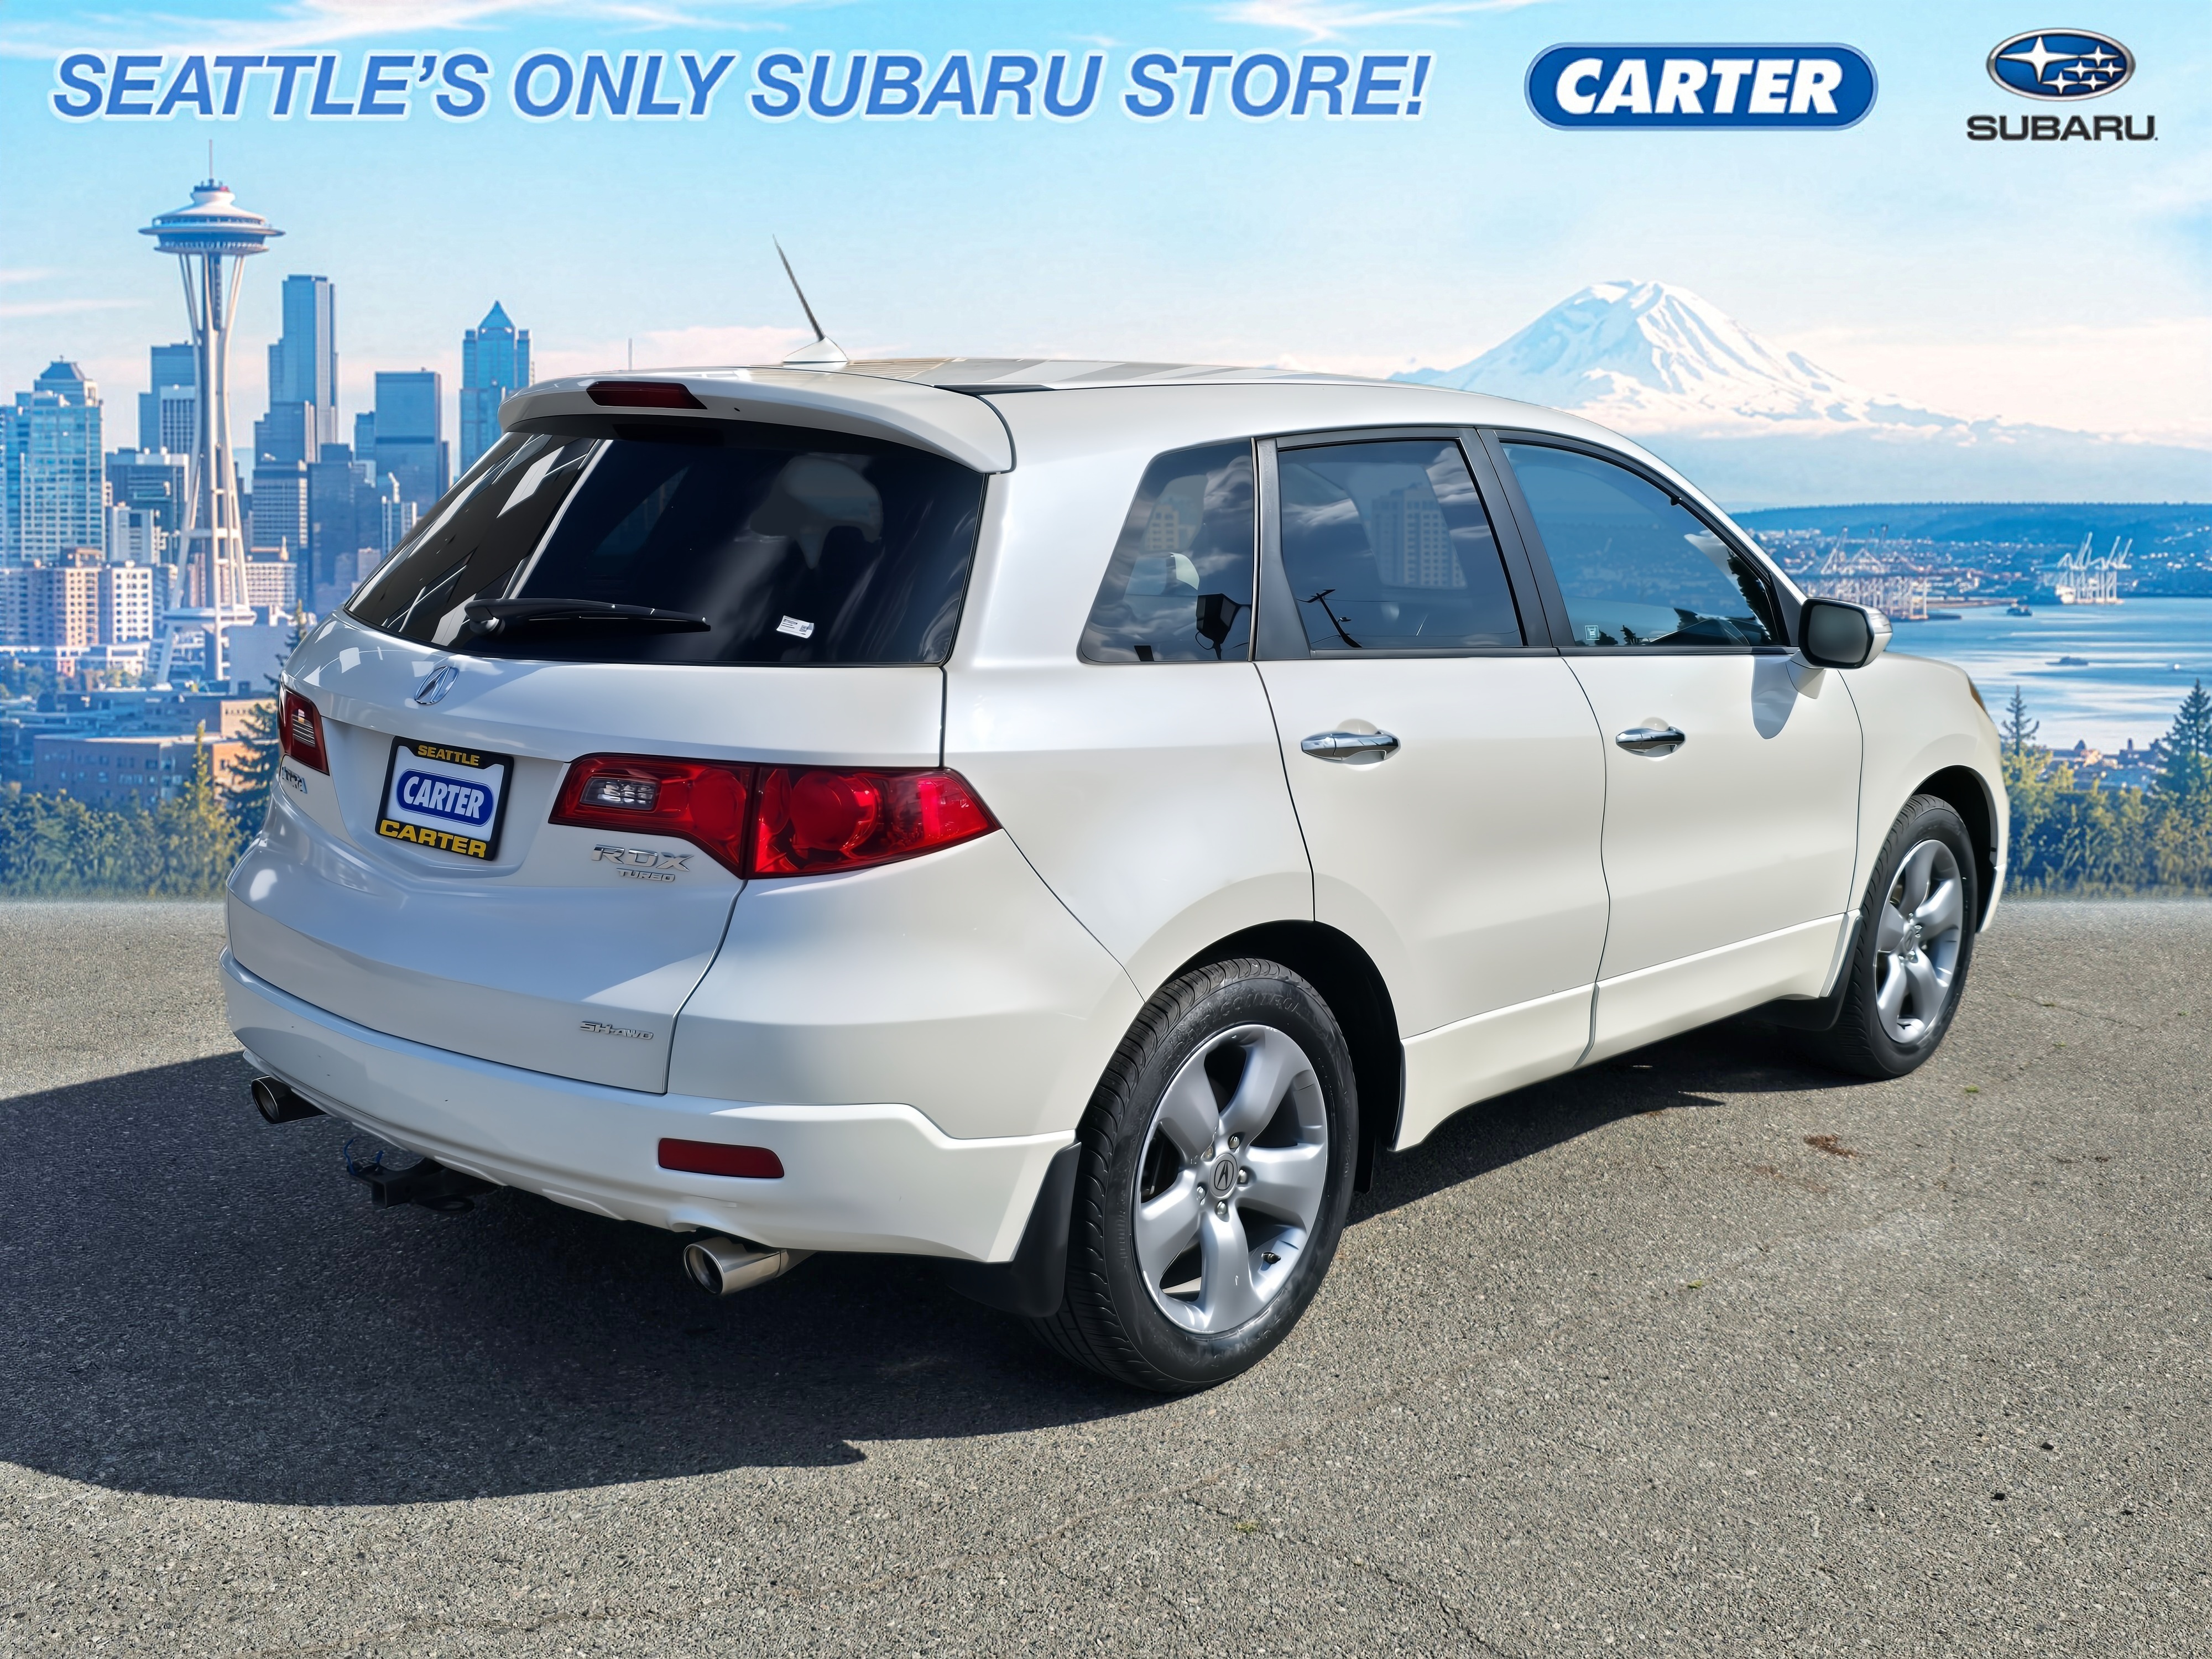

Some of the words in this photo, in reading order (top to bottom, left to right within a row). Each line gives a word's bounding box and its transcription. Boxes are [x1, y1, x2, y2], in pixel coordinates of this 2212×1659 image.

[418, 744, 480, 766] SEATTLE
[403, 776, 484, 818] CARTER
[379, 819, 487, 858] CARTER
[591, 844, 694, 872] RDX
[617, 868, 675, 883] TURBO
[580, 1021, 654, 1040] SH-AWD
